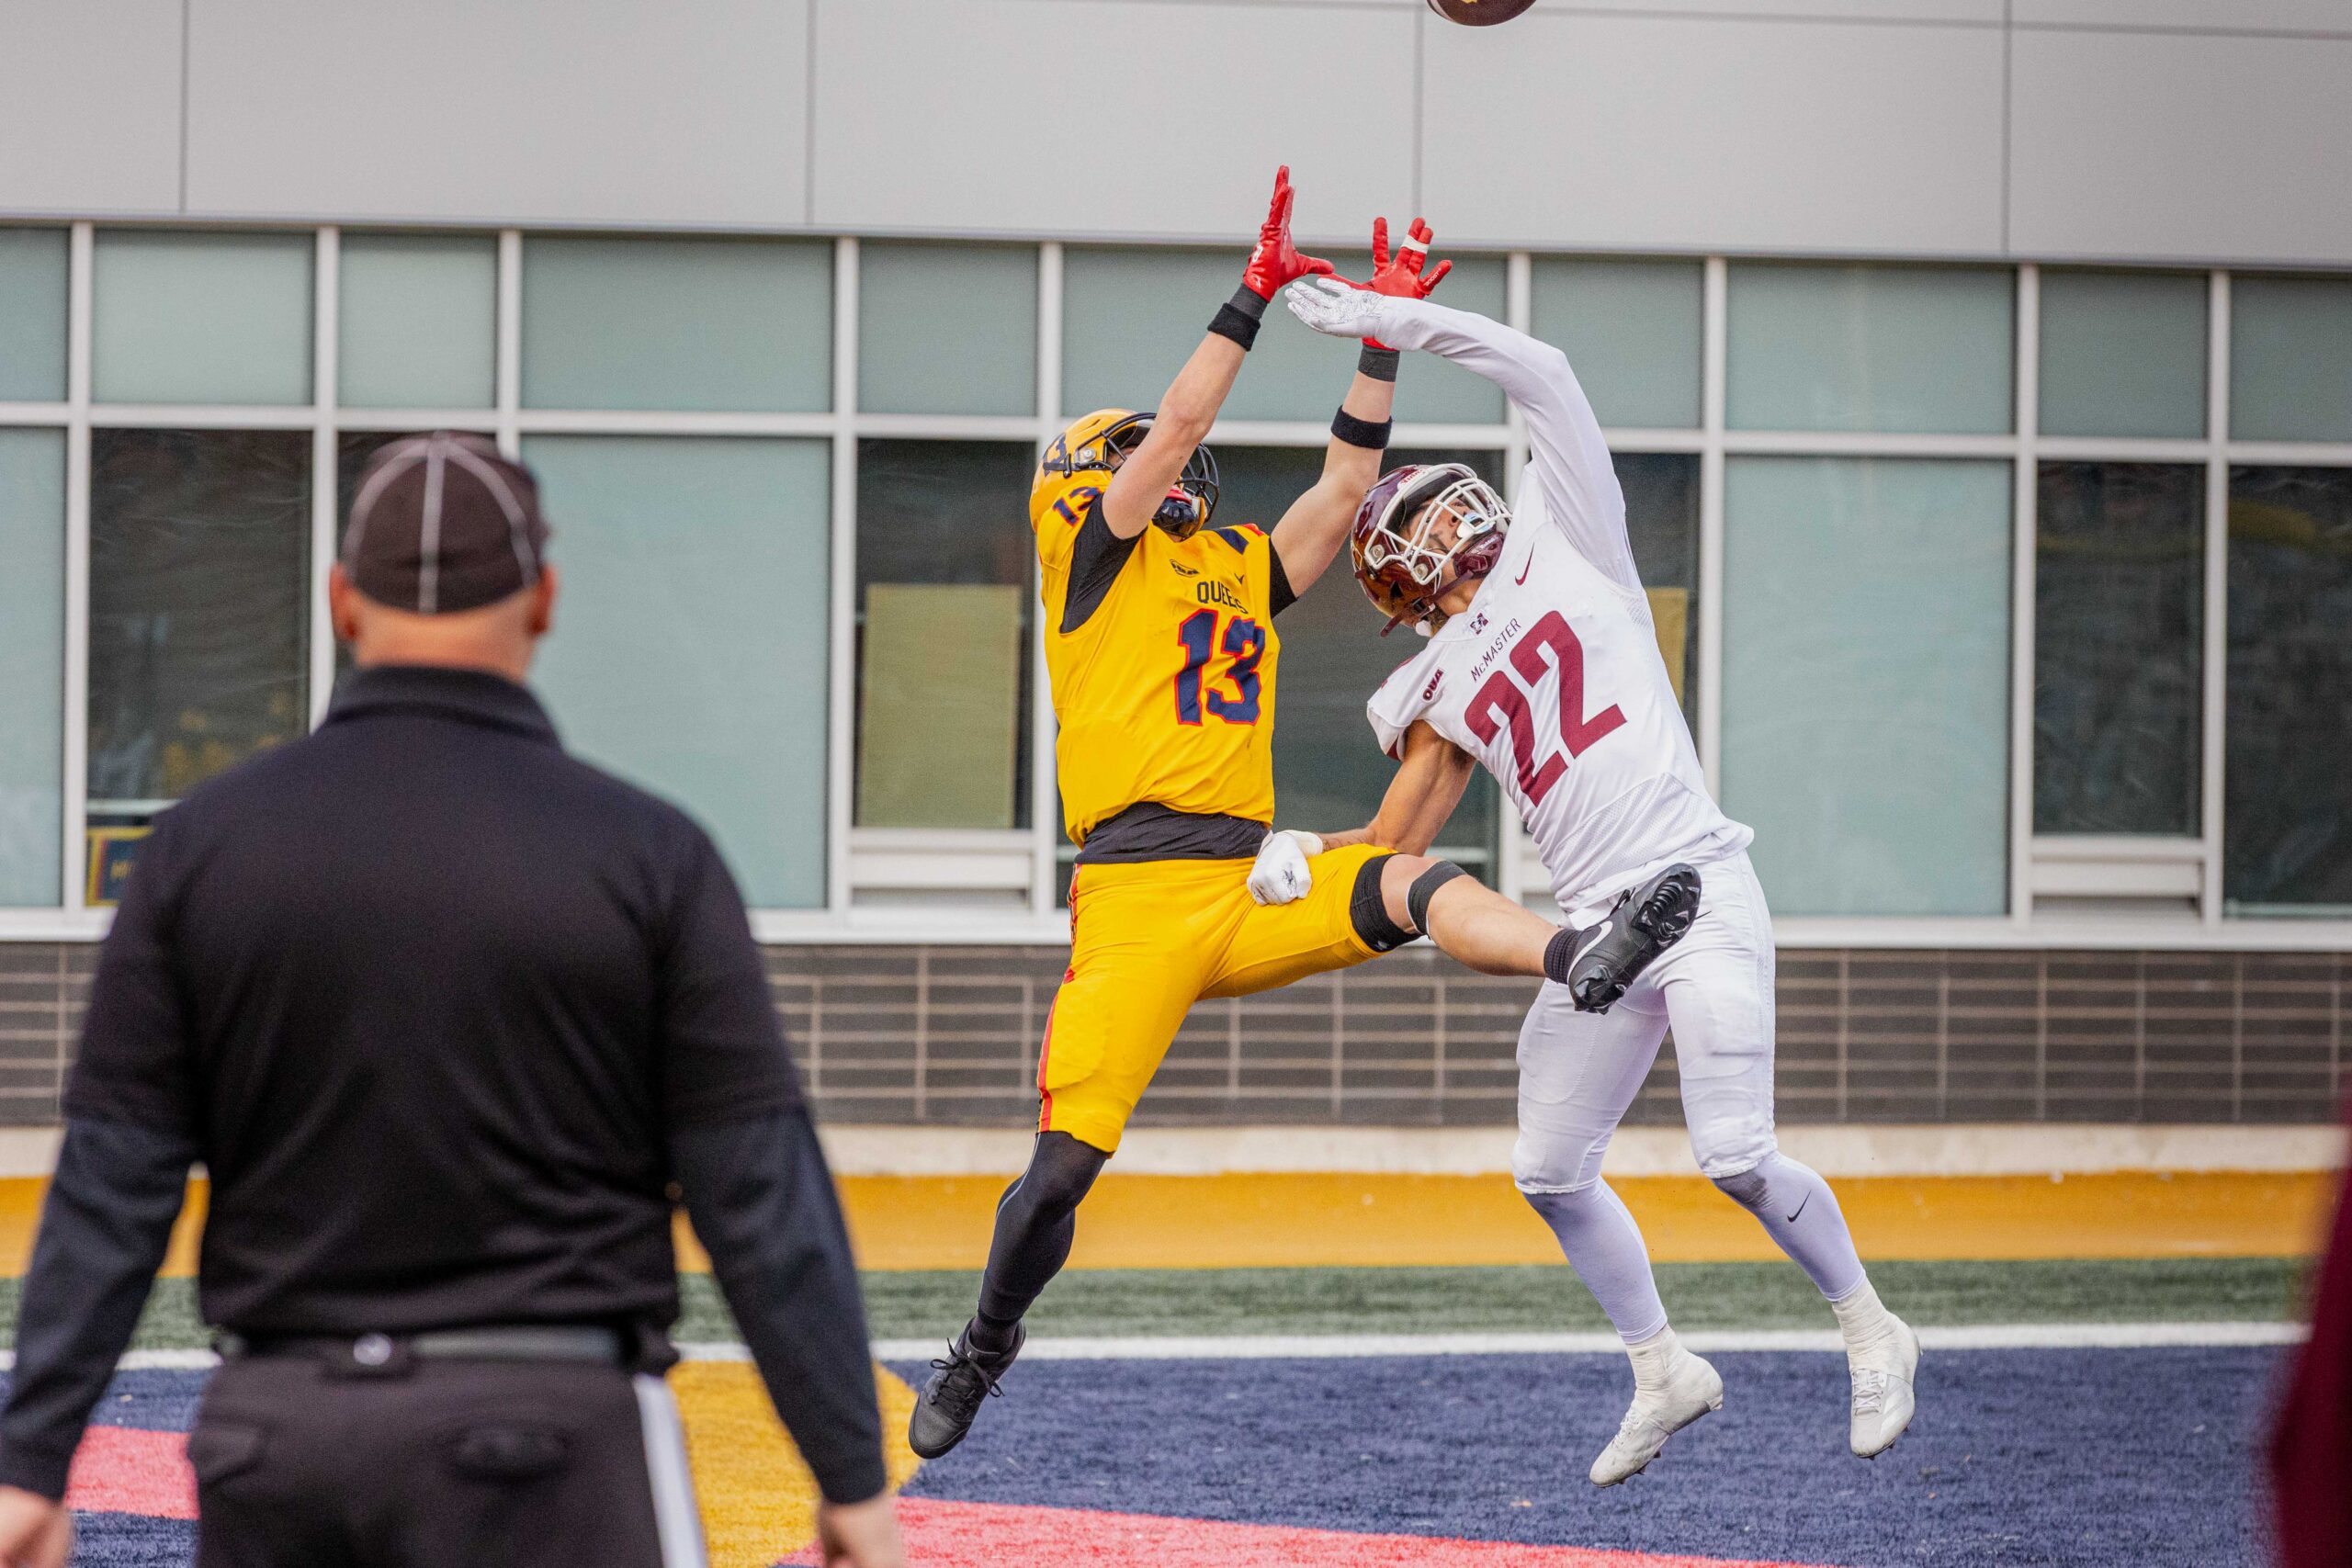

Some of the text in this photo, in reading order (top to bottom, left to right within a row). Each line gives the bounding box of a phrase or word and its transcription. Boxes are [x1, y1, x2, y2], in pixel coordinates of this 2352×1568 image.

[1197, 580, 1249, 614] QUEES
[1174, 608, 1265, 727] 13
[1464, 610, 1628, 807] 22
